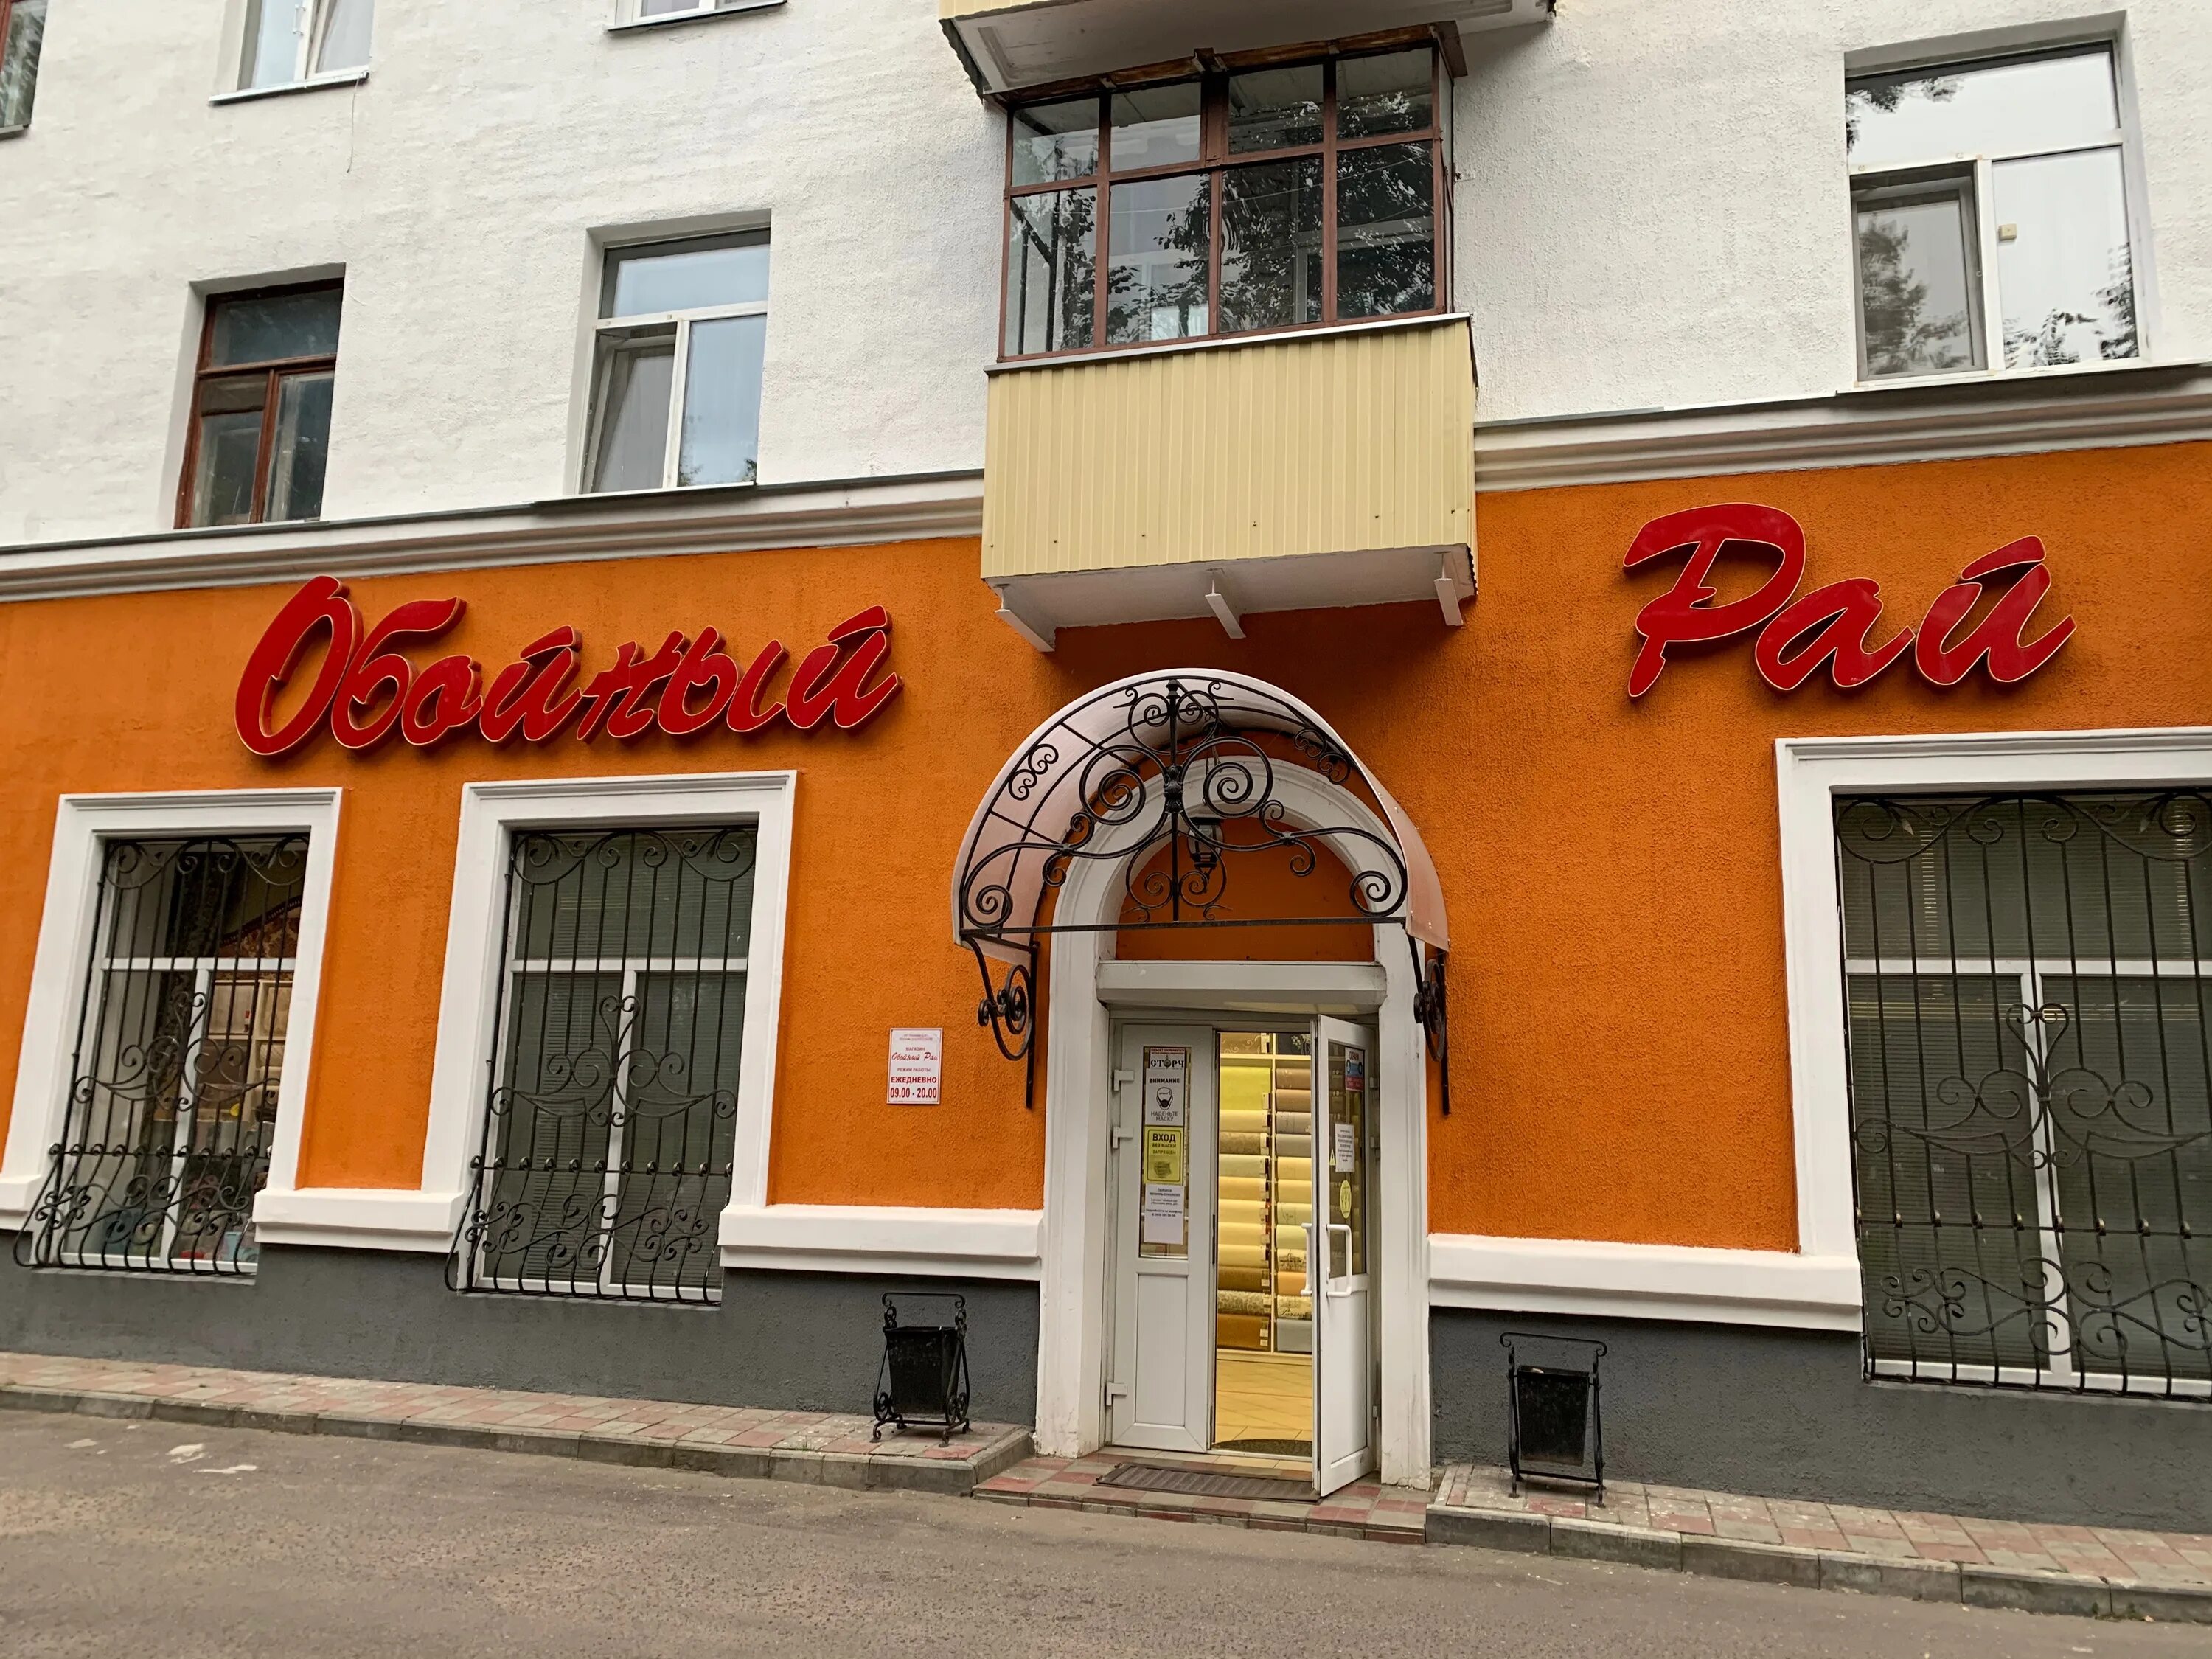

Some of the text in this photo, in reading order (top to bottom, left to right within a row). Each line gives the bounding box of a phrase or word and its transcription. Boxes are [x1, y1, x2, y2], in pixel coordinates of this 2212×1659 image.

[1623, 502, 2077, 699] Рай
[234, 575, 905, 757] Обойный
[891, 1077, 937, 1085] ЕЖЕДНЕВНО
[890, 1088, 911, 1098] 09.00
[917, 1088, 937, 1099] 20.00
[1152, 1133, 1176, 1143] ВХОД
